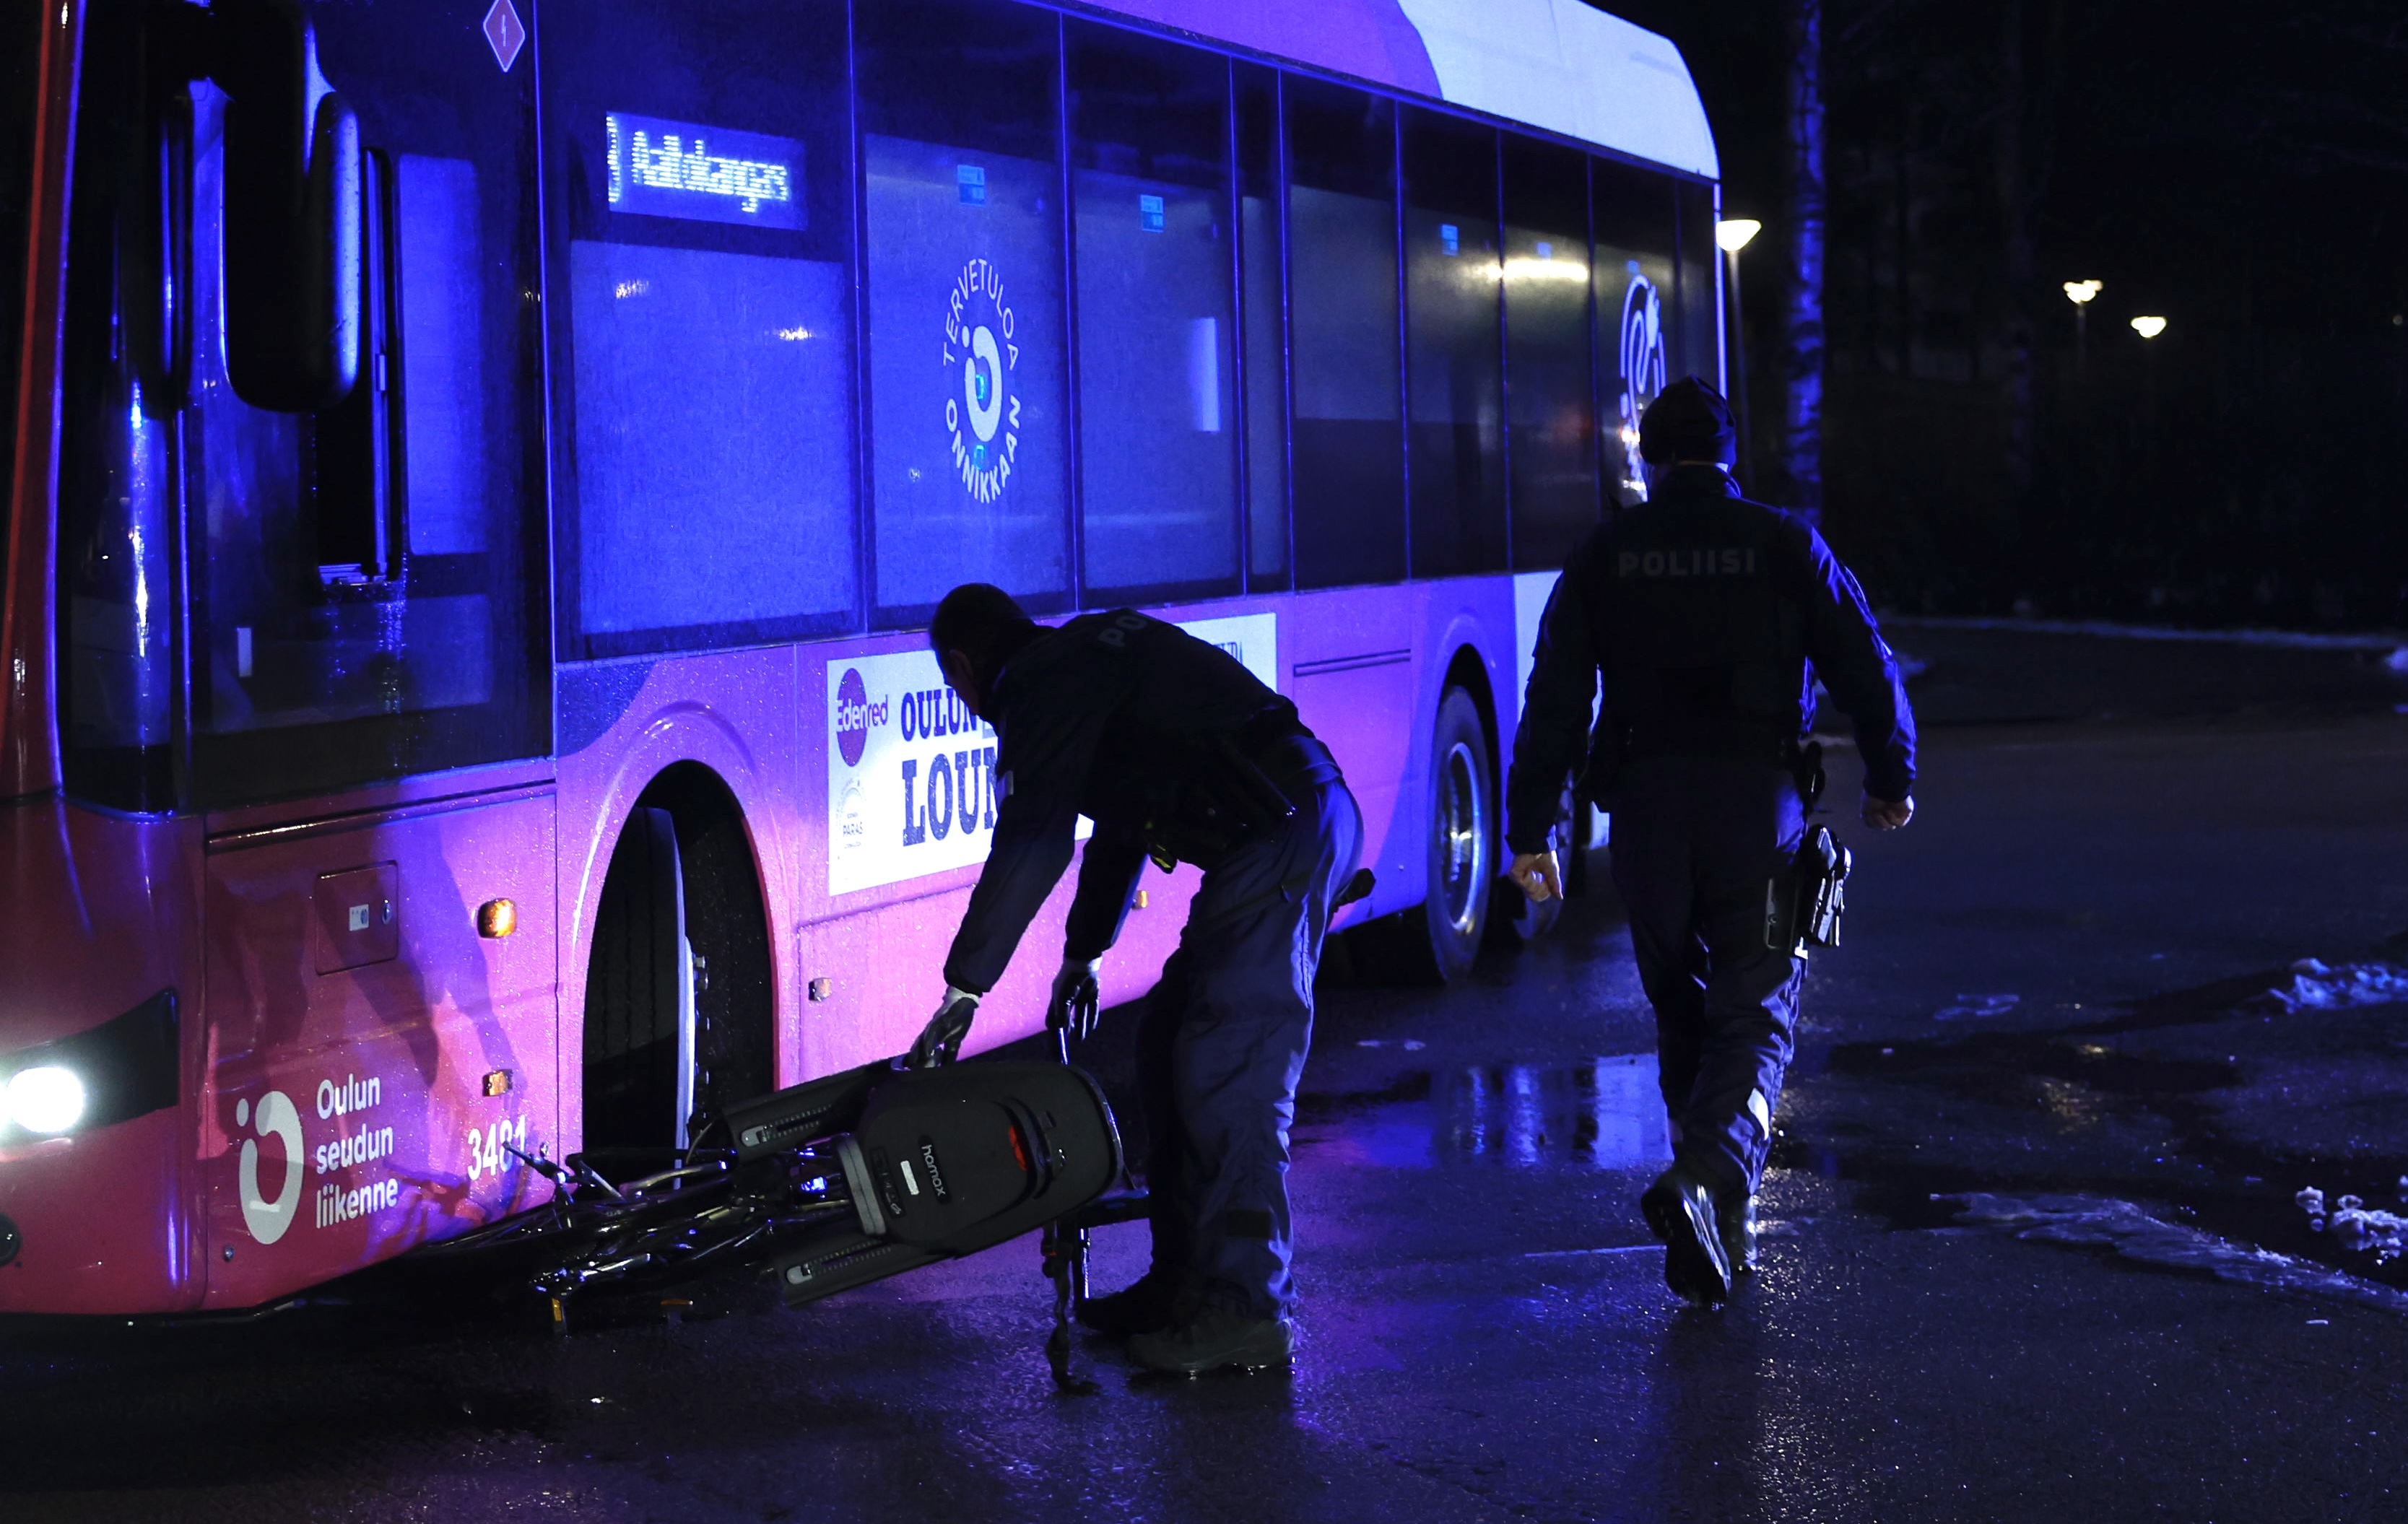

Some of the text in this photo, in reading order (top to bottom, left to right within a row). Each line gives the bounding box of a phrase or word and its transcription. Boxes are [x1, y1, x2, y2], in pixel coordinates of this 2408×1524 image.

[943, 258, 1019, 371] TERVETULOA
[946, 395, 1021, 504] ONNIKKAAN
[1618, 547, 1755, 577] POLIISI
[836, 694, 888, 733] Edenred
[316, 1073, 381, 1120] Oulun
[316, 1123, 394, 1175] seudun
[467, 1114, 526, 1181] 3481
[921, 1144, 946, 1197] hamax
[316, 1177, 399, 1229] liikenne
